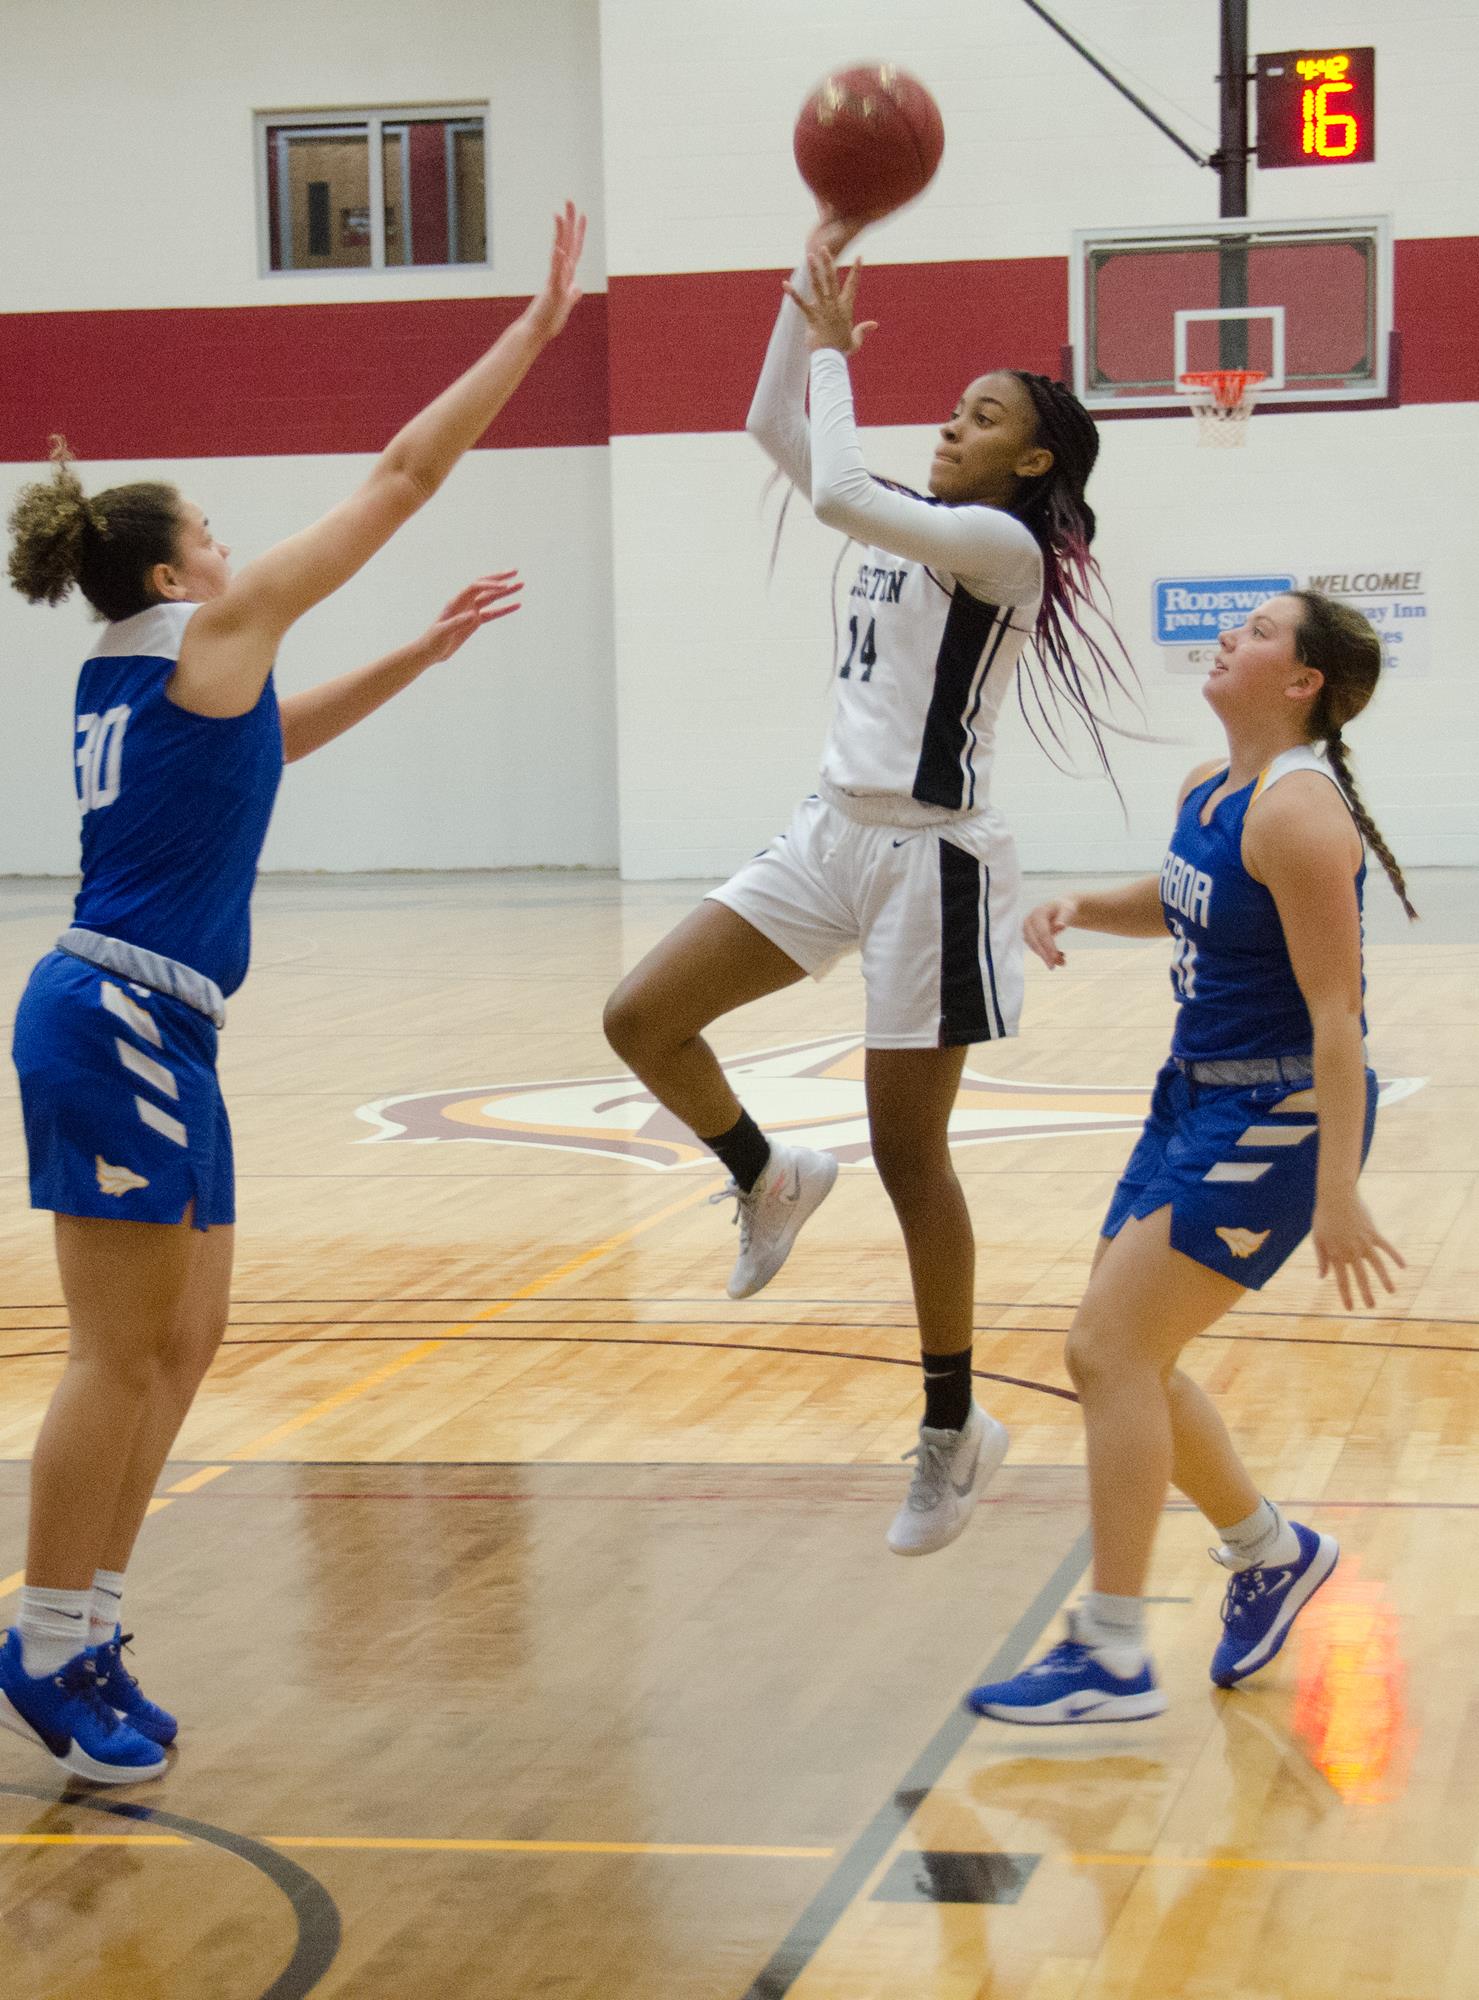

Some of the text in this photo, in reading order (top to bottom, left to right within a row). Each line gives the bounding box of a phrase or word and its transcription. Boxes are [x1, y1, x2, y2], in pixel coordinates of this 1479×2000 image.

[1302, 81, 1357, 157] 16
[1307, 572, 1422, 592] WELCOME!
[1202, 612, 1217, 627] &
[1392, 603, 1426, 618] Inn
[839, 615, 877, 683] 14
[76, 703, 132, 816] 30
